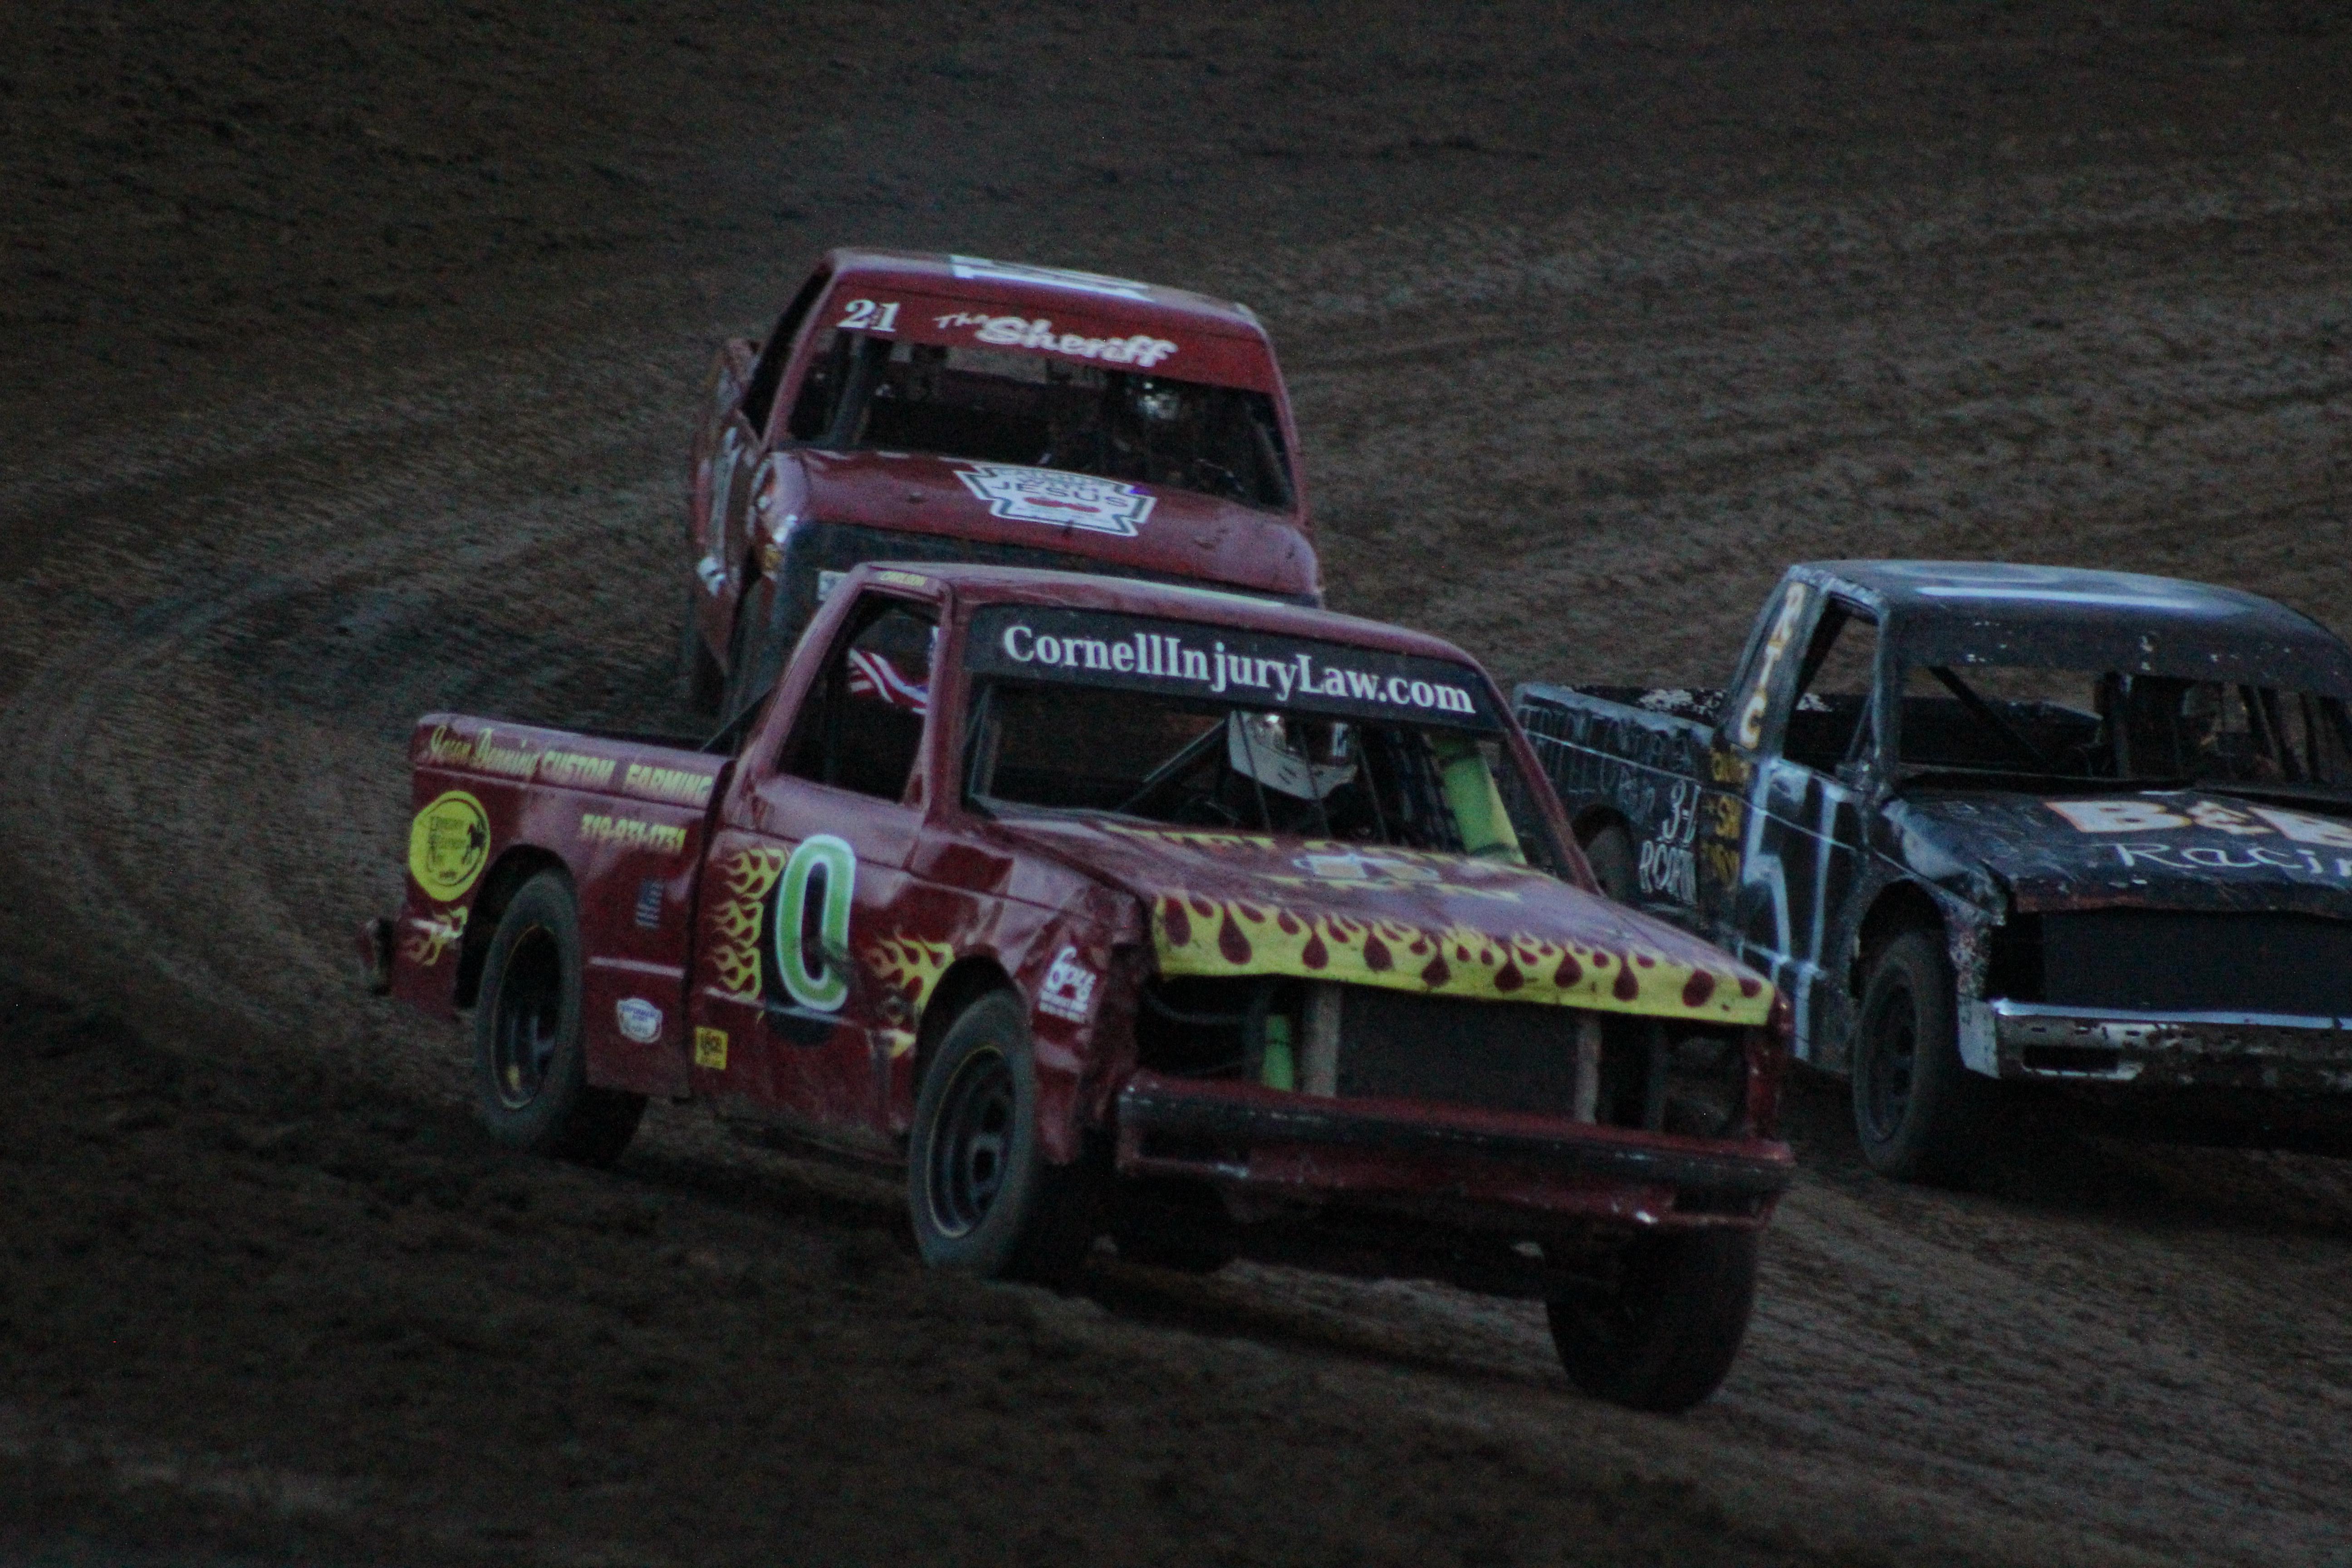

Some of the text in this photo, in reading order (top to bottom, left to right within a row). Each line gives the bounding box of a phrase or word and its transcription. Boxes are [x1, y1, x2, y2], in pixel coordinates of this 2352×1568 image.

[837, 299, 900, 333] 21
[975, 315, 1178, 368] Sheriff
[991, 481, 1128, 507] JESUS
[1003, 625, 1476, 715] CornellInjuryLaw.com
